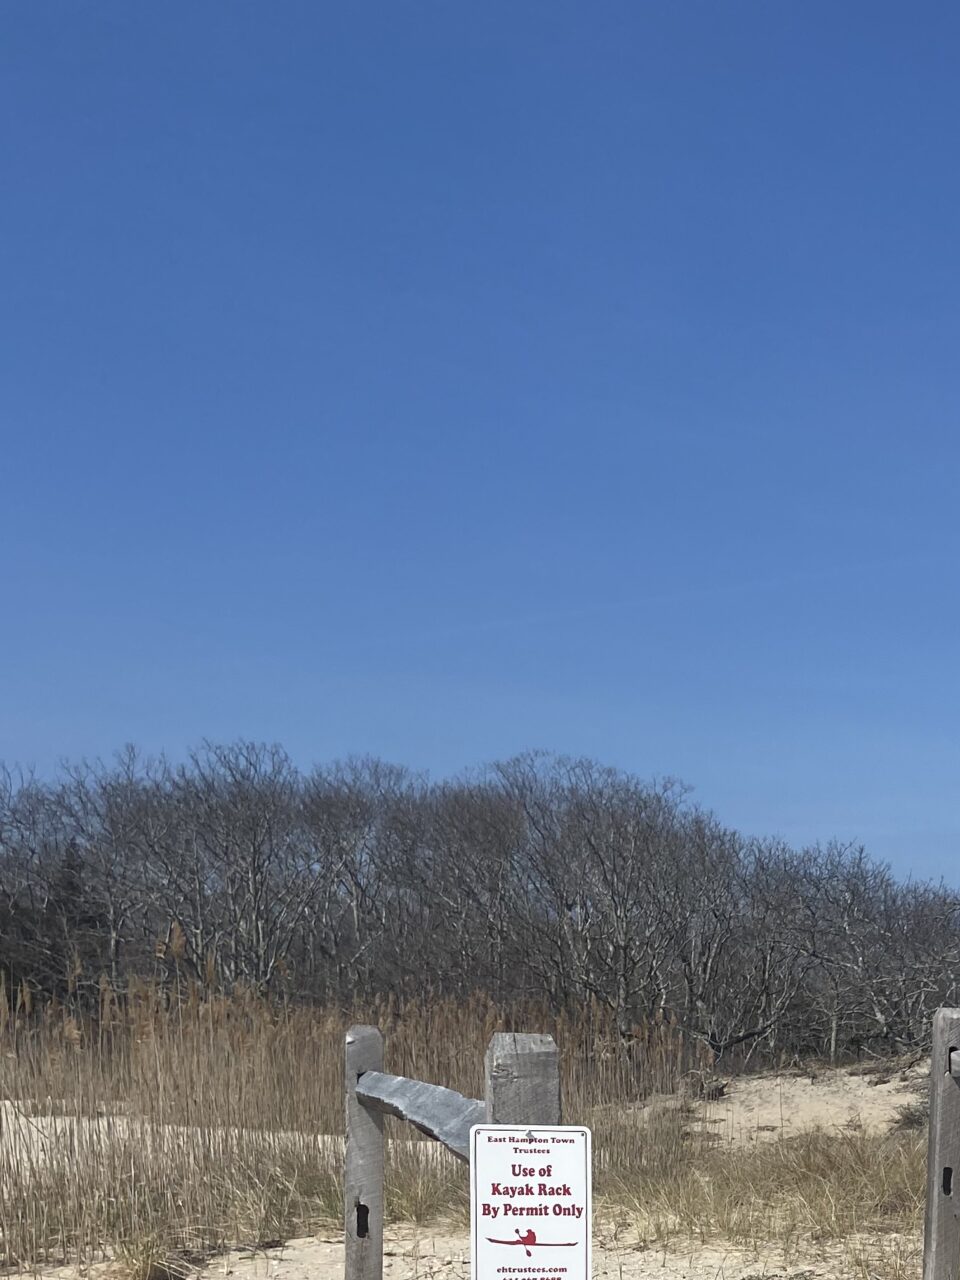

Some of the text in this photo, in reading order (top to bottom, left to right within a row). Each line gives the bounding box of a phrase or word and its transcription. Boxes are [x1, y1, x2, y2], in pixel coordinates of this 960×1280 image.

[511, 1165, 552, 1177] Use of
[491, 1183, 571, 1198] Kayak Rack
[482, 1204, 583, 1218] By Permit Only
